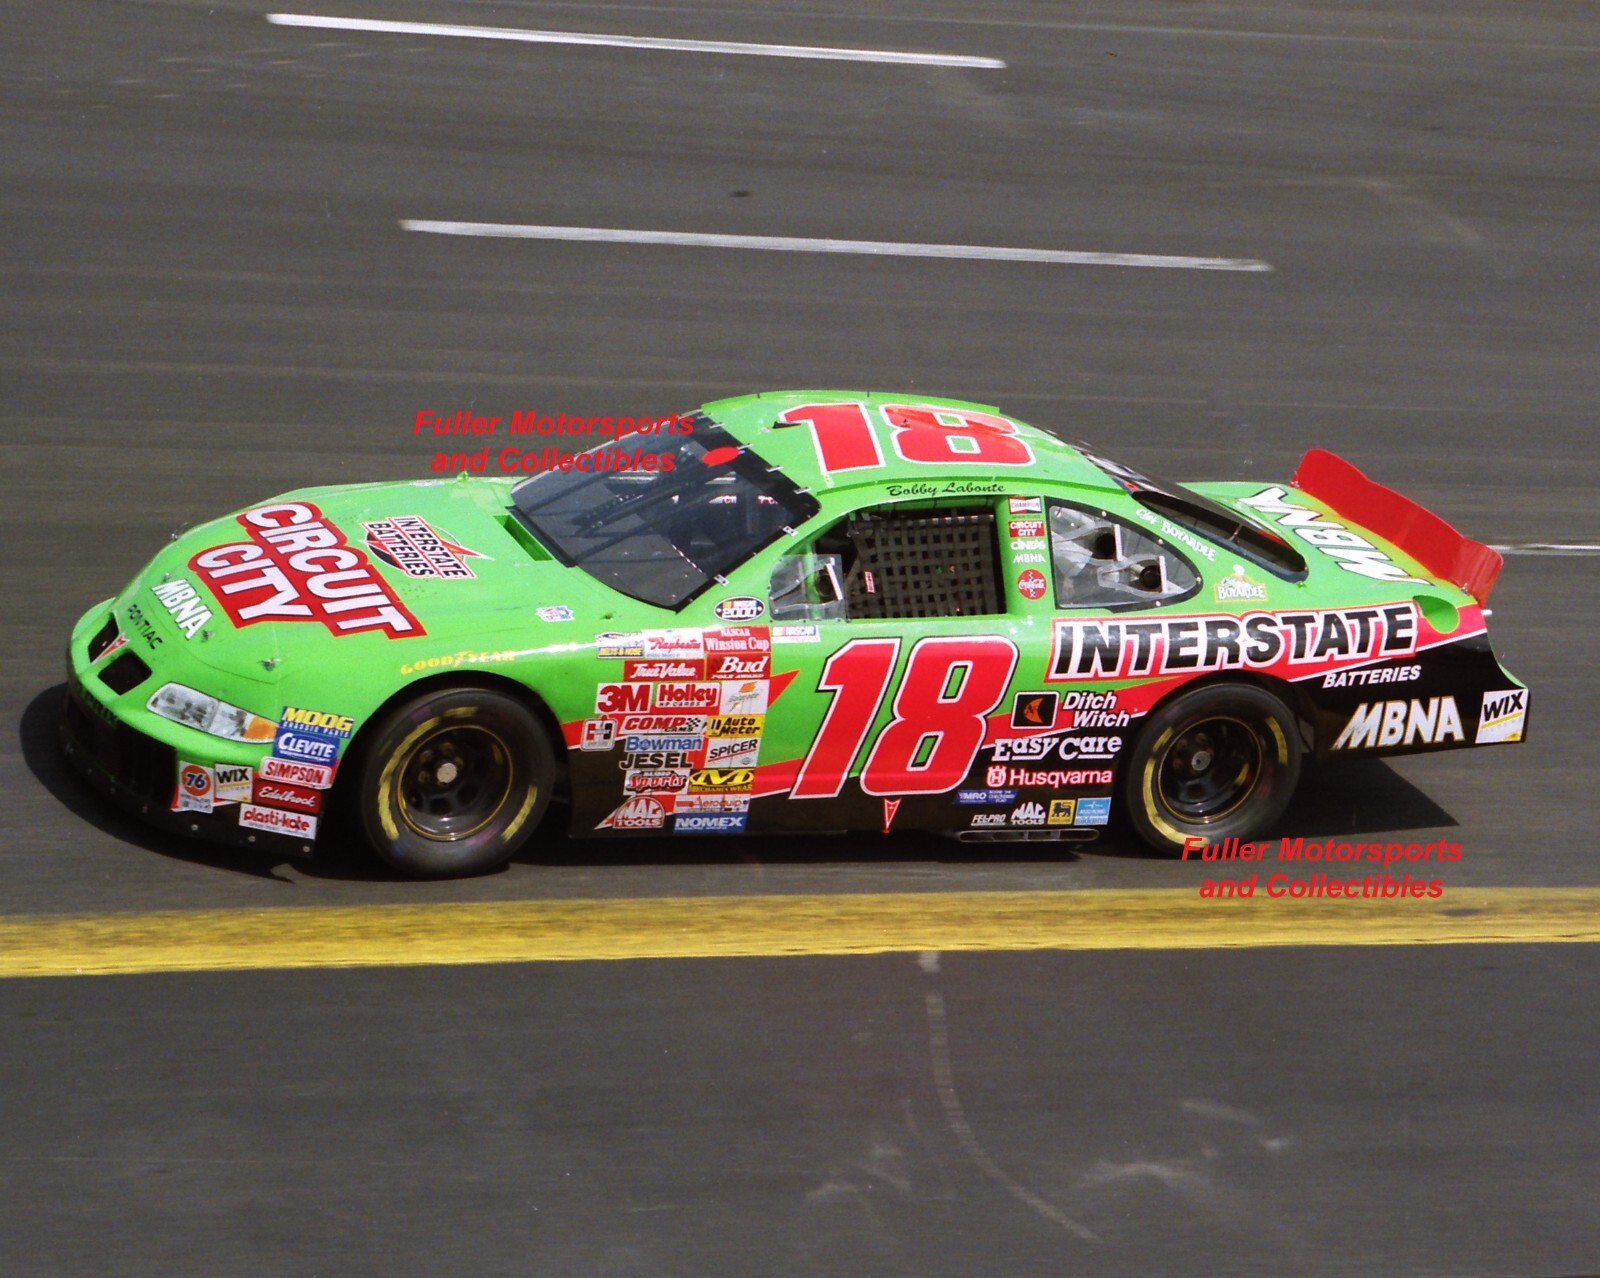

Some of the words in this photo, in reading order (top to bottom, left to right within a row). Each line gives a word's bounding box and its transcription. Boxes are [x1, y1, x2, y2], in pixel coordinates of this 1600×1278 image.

[778, 402, 1036, 475] 18
[886, 483, 937, 497] Bobby
[942, 482, 1006, 493] Labonte
[1010, 521, 1042, 530] CIRCUIT
[1018, 529, 1036, 537] CITY
[368, 523, 435, 576] BATTERIES
[393, 517, 469, 577] INTERSTATE
[245, 502, 413, 632] CIRCUIT
[1013, 553, 1046, 564] MBNA
[197, 544, 314, 620] CITY
[150, 578, 215, 640] MBNA
[722, 607, 757, 618] 2000
[128, 604, 163, 650] PONTIAC
[721, 628, 751, 637] NASCAR
[705, 637, 747, 650] Winston
[748, 637, 770, 651] Cup
[1052, 604, 1417, 679] INTERSTATE
[716, 656, 769, 673] Bud
[1323, 665, 1421, 689] BATTERIES
[597, 685, 651, 713] 3M
[658, 684, 718, 707] Holley
[1063, 691, 1118, 710] Ditch
[1484, 691, 1523, 722] WIX
[282, 707, 354, 732] MOOG
[624, 717, 687, 730] COMP
[724, 717, 756, 726] Auto
[788, 636, 1020, 800] 18
[1073, 711, 1132, 728] Witch
[1329, 696, 1465, 750] MBNA
[720, 726, 760, 735] Meter
[278, 732, 336, 758] CLEVITE
[626, 736, 702, 751] Bowman
[709, 739, 758, 759] SPICER
[620, 753, 693, 769] JESEL
[185, 773, 206, 789] 76
[216, 768, 250, 784] WIX
[265, 761, 325, 784] SIMPSON
[1009, 768, 1113, 789] Husqvarna
[259, 787, 316, 807] Edelbrock
[618, 799, 662, 819] MAC
[1011, 801, 1046, 820] MAC
[243, 808, 310, 833] plasti-kote
[618, 819, 661, 827] TOOLS
[675, 817, 744, 827] NOMEX
